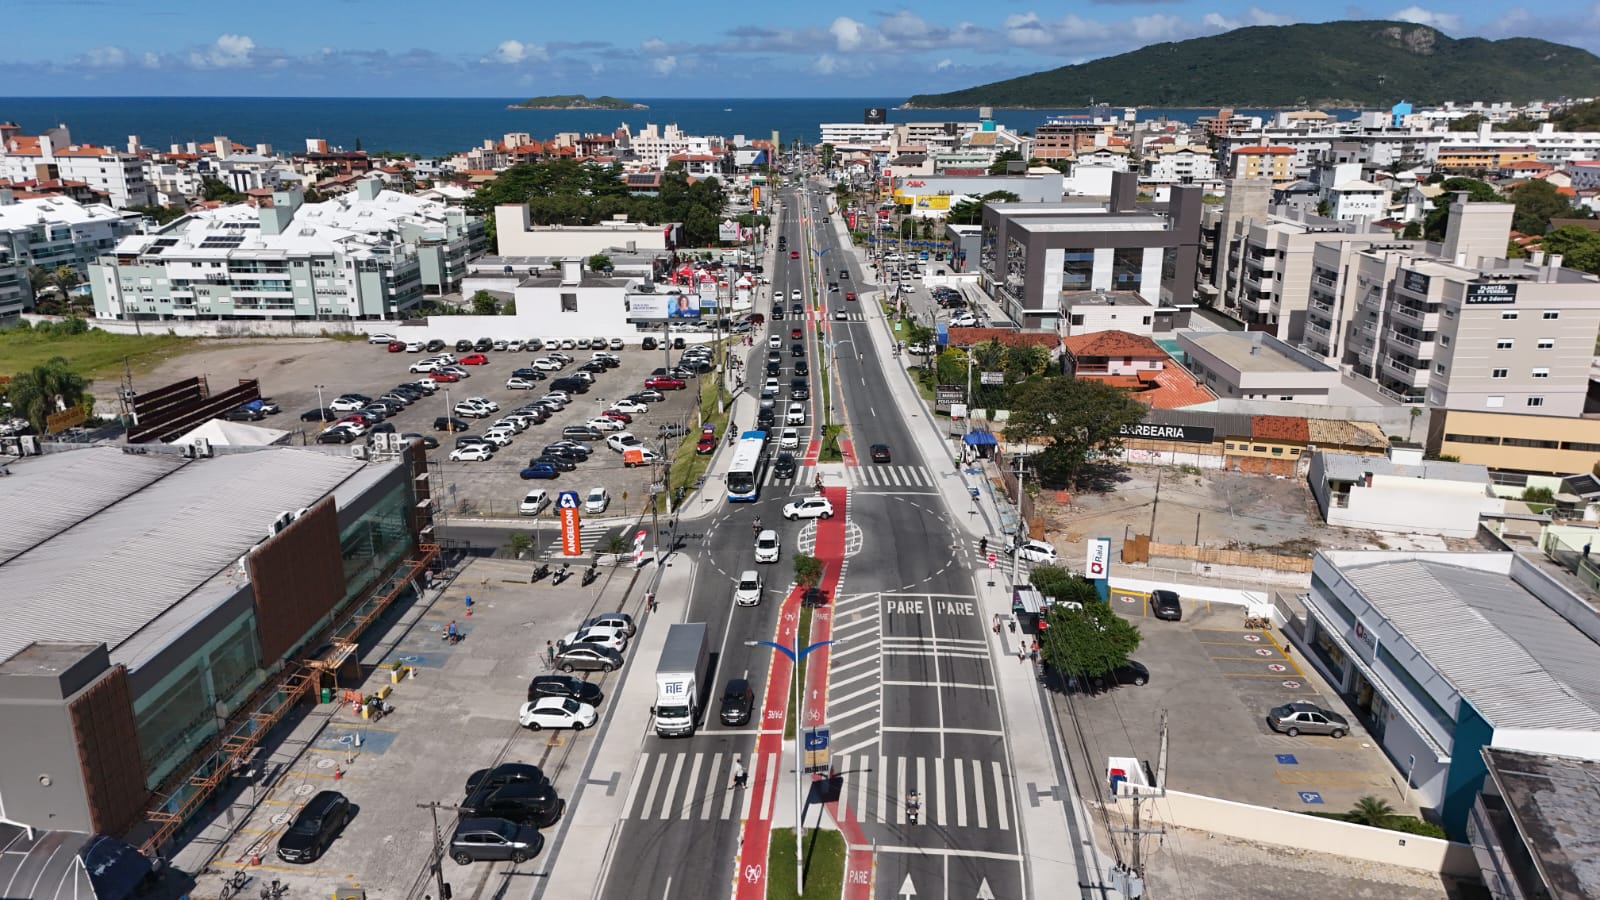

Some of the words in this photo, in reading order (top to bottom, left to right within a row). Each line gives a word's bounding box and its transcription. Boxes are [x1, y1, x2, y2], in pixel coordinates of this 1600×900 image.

[1120, 424, 1184, 438] BARBEARIA
[565, 509, 576, 553] ANGELONI
[1094, 544, 1104, 562] Raia
[887, 600, 924, 614] PARE
[936, 601, 975, 616] PARE
[849, 870, 869, 884] PARE
